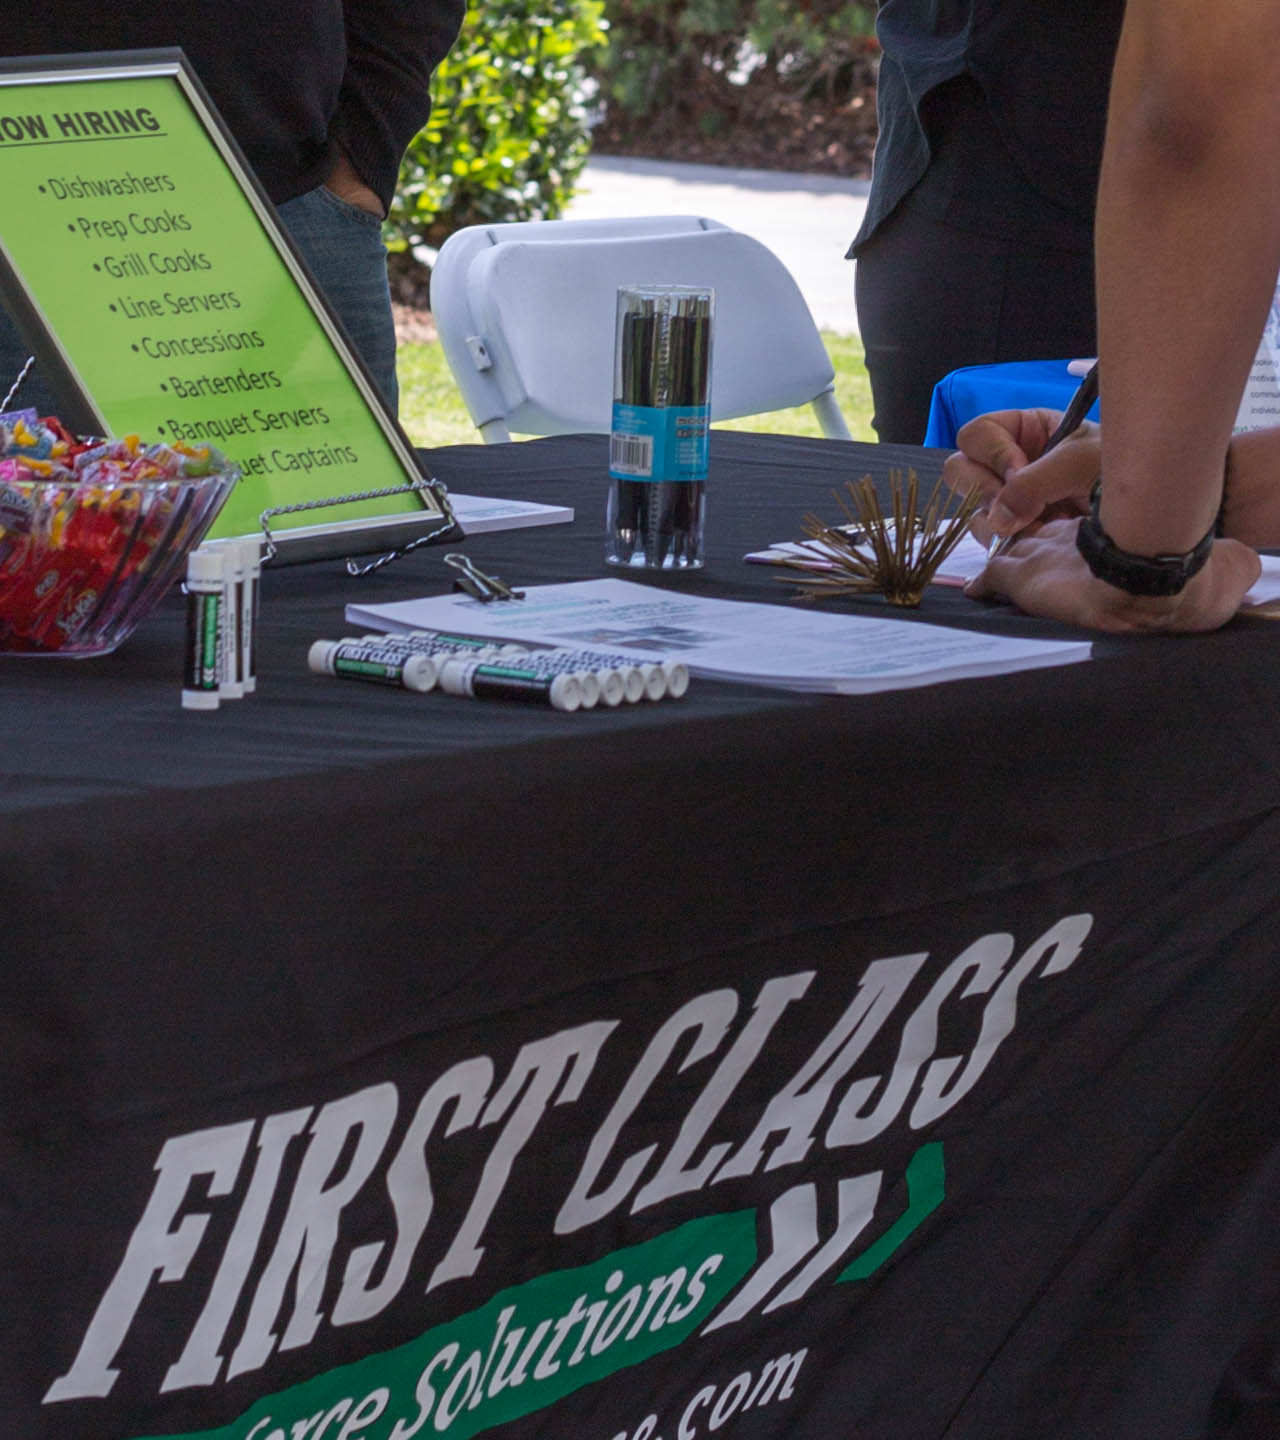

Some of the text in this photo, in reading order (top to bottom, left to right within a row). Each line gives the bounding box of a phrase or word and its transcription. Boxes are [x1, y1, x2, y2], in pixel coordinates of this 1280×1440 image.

[53, 108, 161, 137] HIRING
[47, 172, 177, 201] Dishwashers
[76, 209, 193, 242] Prep Cooks
[103, 248, 213, 279] Grill Cooks
[118, 290, 242, 320] Line Servers
[141, 329, 265, 360] Concessions
[168, 368, 283, 400] Bartenders
[166, 406, 331, 443] Banquet Servers
[271, 442, 359, 475] Captains
[40, 913, 1094, 1405] FIRST CLASS
